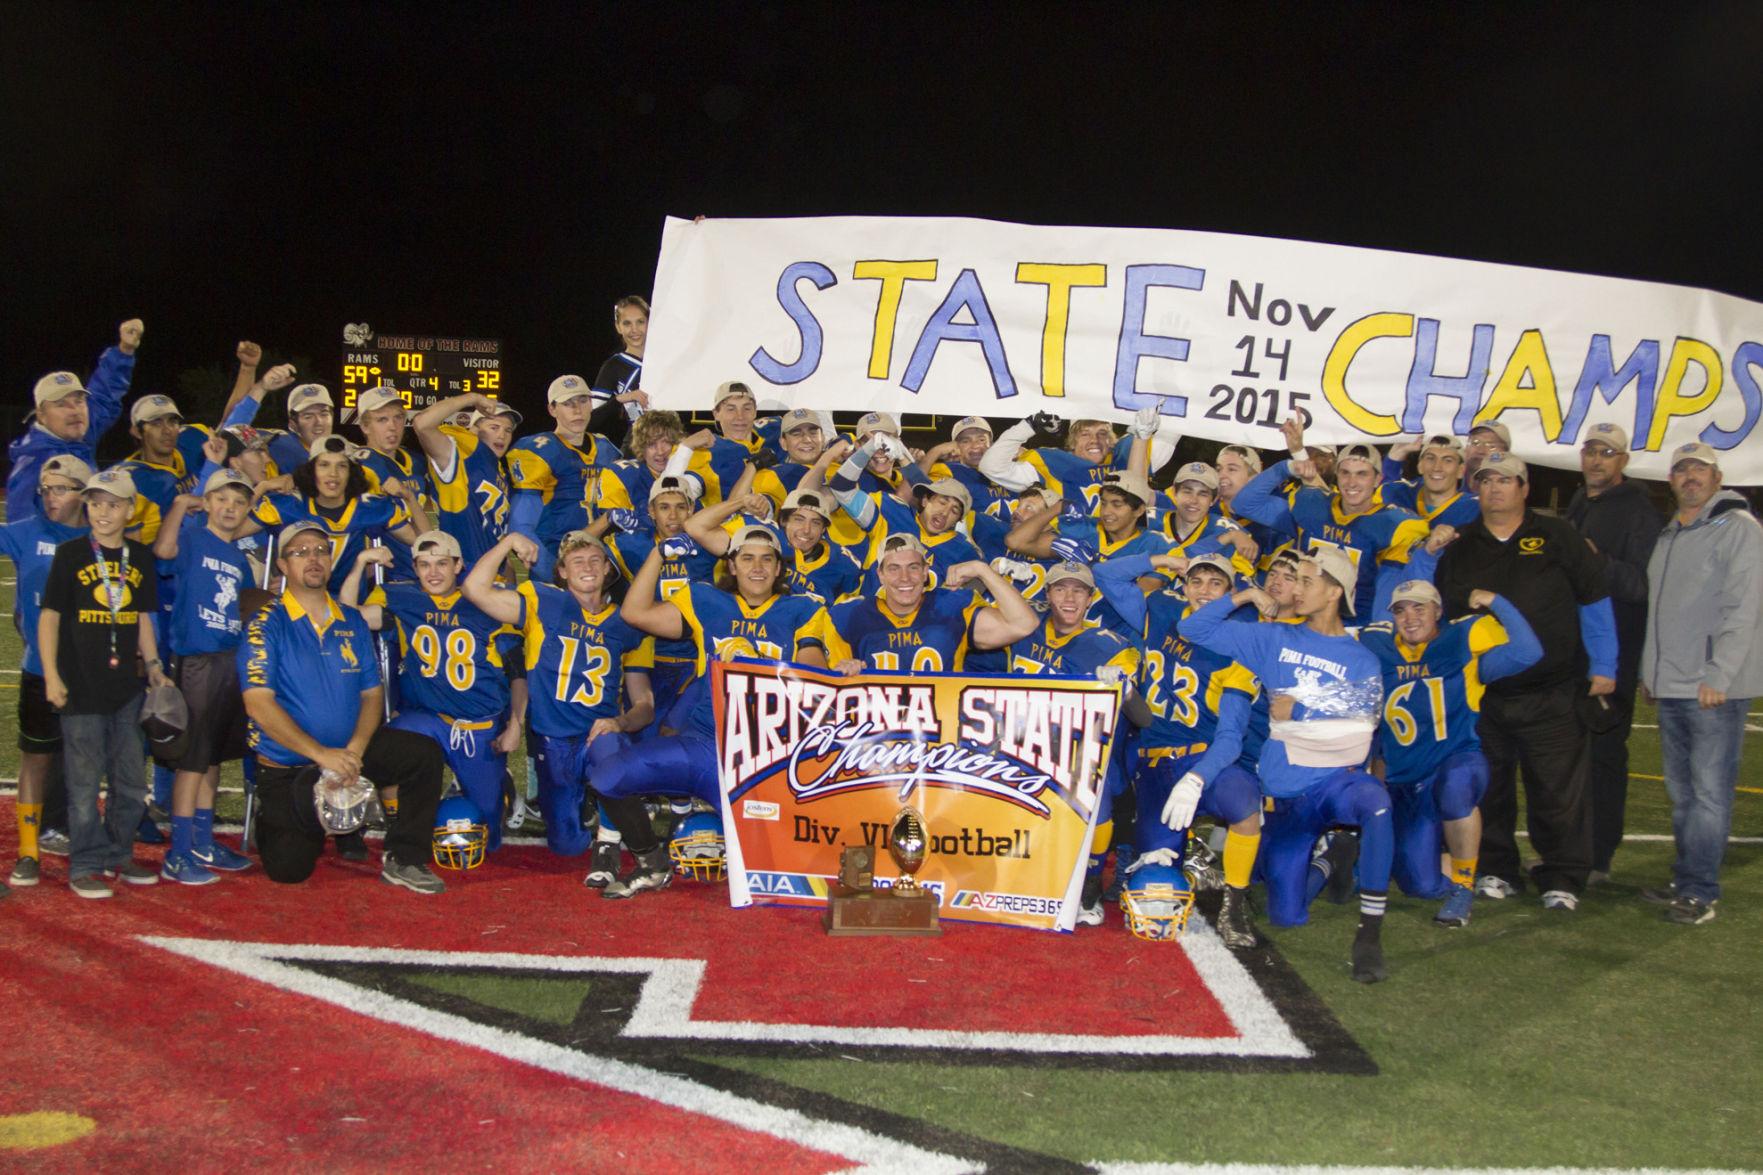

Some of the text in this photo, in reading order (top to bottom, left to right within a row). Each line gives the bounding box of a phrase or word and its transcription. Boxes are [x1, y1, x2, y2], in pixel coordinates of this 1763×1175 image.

[1226, 279, 1336, 332] Nov
[377, 336, 499, 353] HOME OF THE RAMS
[748, 258, 1206, 417] STATE
[347, 353, 379, 364] RAMS
[463, 358, 500, 368] VISITOR
[1231, 335, 1291, 381] 14
[343, 365, 368, 384] 59
[383, 378, 395, 387] TOL
[409, 378, 426, 388] QTR
[428, 376, 439, 391] 4
[449, 381, 461, 389] TOL
[476, 370, 500, 389] 32
[1320, 311, 1763, 452] CHAMPS
[462, 380, 471, 392] 3
[414, 395, 437, 406] TO GO
[1203, 384, 1313, 432] 2015
[1322, 525, 1352, 545] PIMA
[660, 562, 688, 577] PIMA
[785, 568, 816, 592] PIMA
[425, 611, 460, 627] PIMA
[731, 620, 768, 638] PIMA
[570, 621, 604, 645] PIMA
[888, 631, 923, 649] PIMA
[411, 624, 477, 692] 98
[1031, 642, 1063, 669] PIMA
[1162, 635, 1193, 662] PIMA
[555, 635, 612, 707] 13
[1278, 647, 1347, 681] PIMA FOOTBALL
[1396, 663, 1431, 679] PIMA
[1144, 646, 1200, 728] 23
[1383, 676, 1448, 746] 61
[724, 671, 1116, 813] ARIZONA STATE
[788, 720, 1052, 806] Champions
[793, 815, 846, 846] Div.
[930, 827, 1031, 859] ootball
[749, 873, 796, 894] AIA
